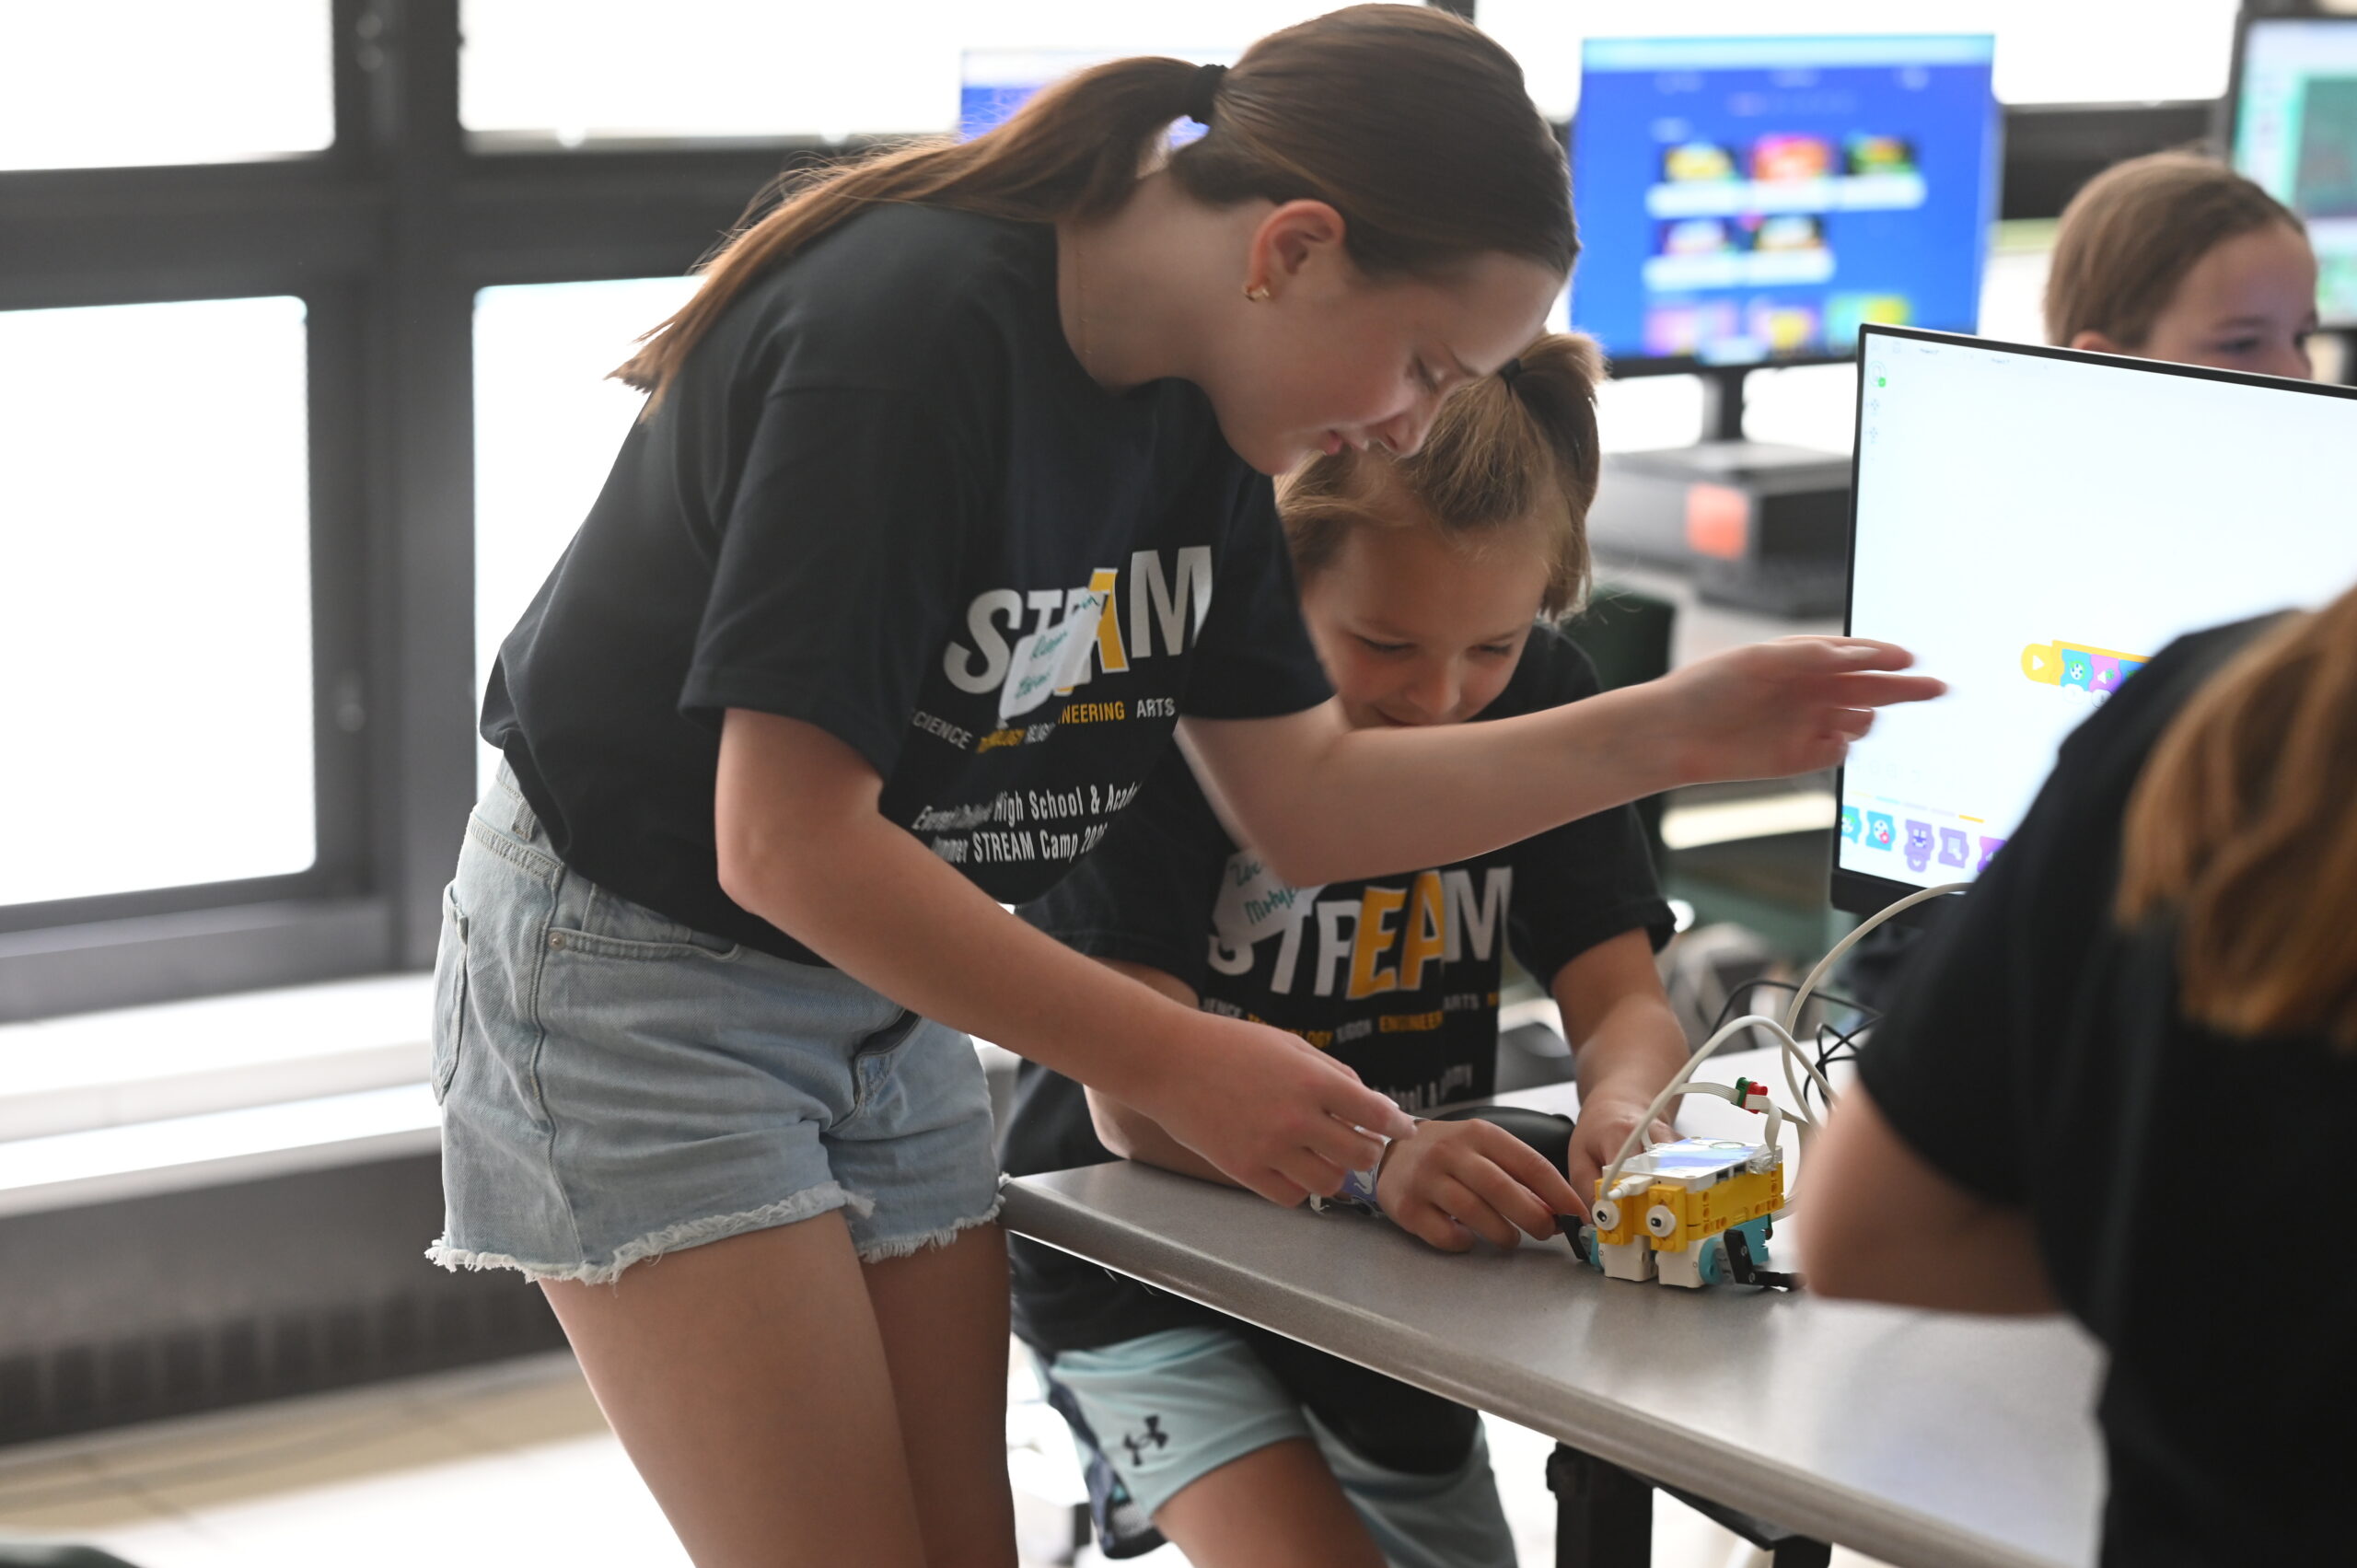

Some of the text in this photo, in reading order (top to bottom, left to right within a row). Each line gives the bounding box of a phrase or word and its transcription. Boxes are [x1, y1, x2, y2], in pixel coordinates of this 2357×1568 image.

[911, 711, 973, 750] CIENCE
[1059, 701, 1125, 725] NEERING
[1136, 697, 1176, 719] ARTS
[993, 790, 1024, 828] High
[1028, 785, 1084, 821] School
[1090, 784, 1100, 815] &
[972, 831, 1036, 864] STREAM
[1039, 829, 1078, 864] Camp
